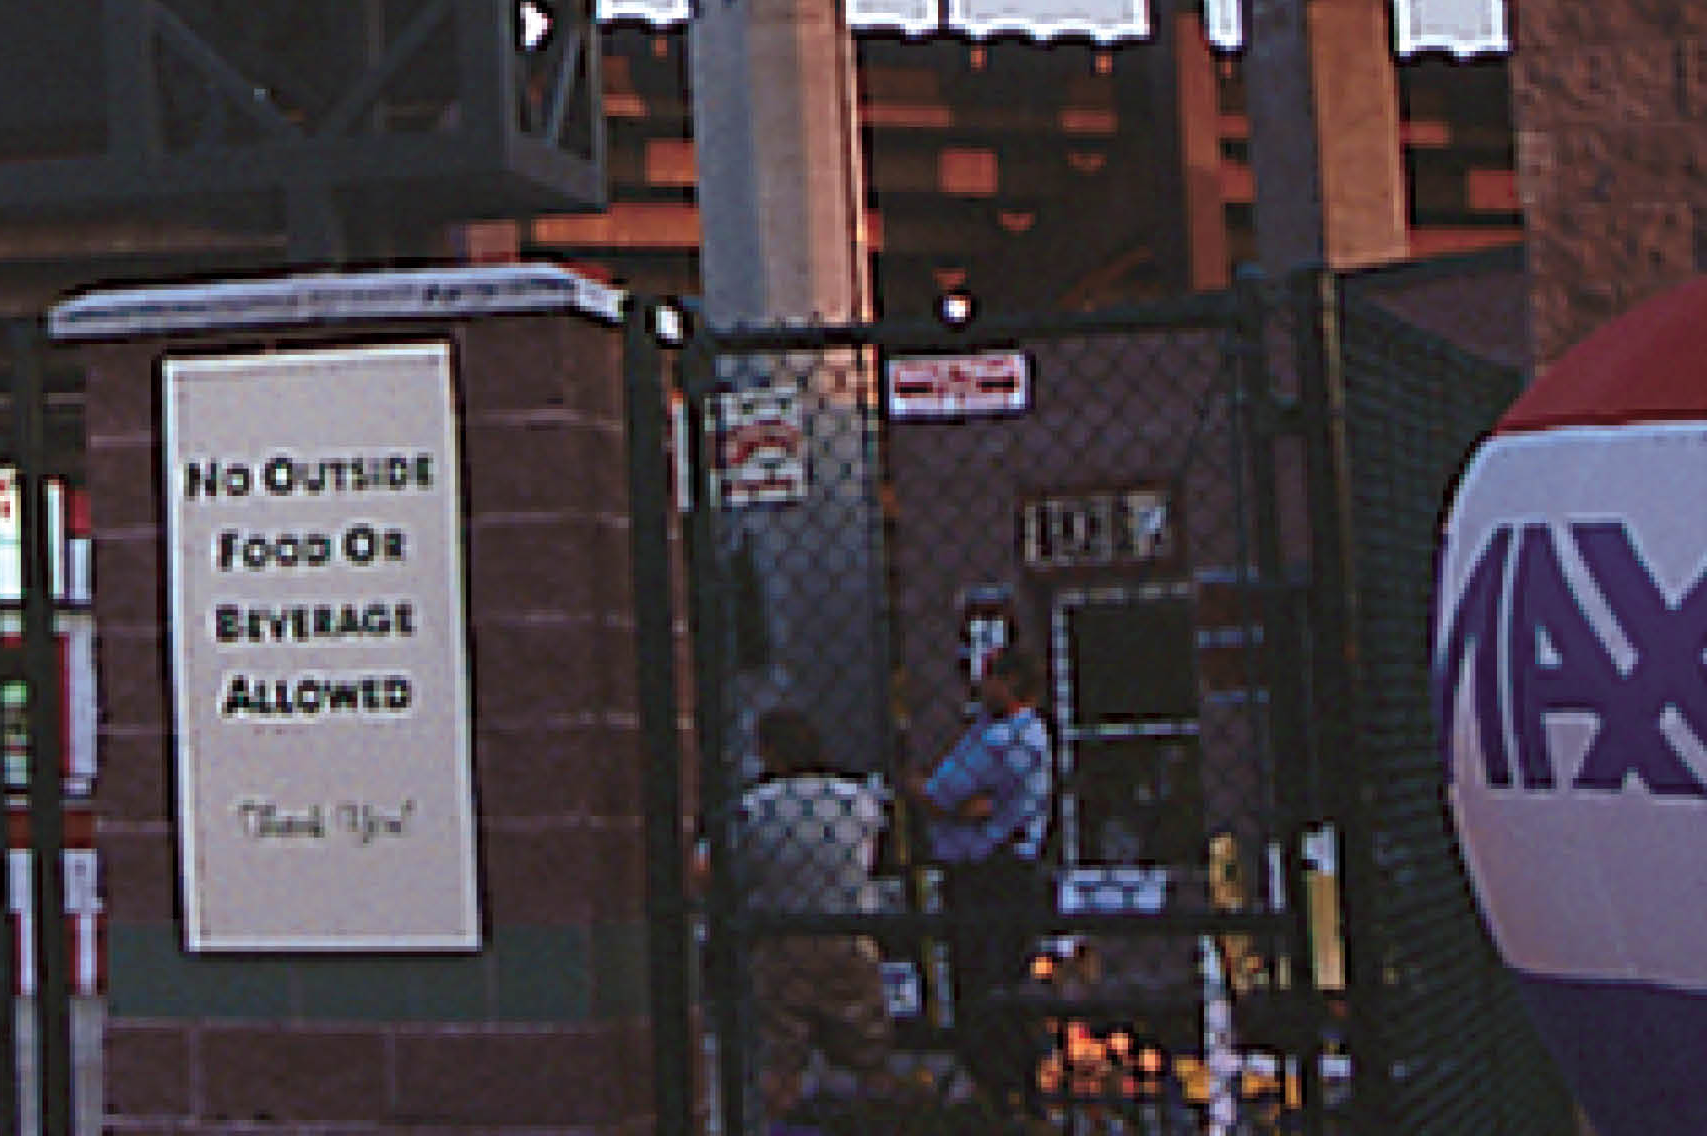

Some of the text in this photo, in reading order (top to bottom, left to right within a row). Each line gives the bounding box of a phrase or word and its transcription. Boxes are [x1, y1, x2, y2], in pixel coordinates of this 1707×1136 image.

[264, 454, 434, 496] OUTSIDE
[217, 523, 405, 570] FOOD OR
[215, 604, 416, 643] BEVERAGE
[222, 675, 413, 716] ALLOWED
